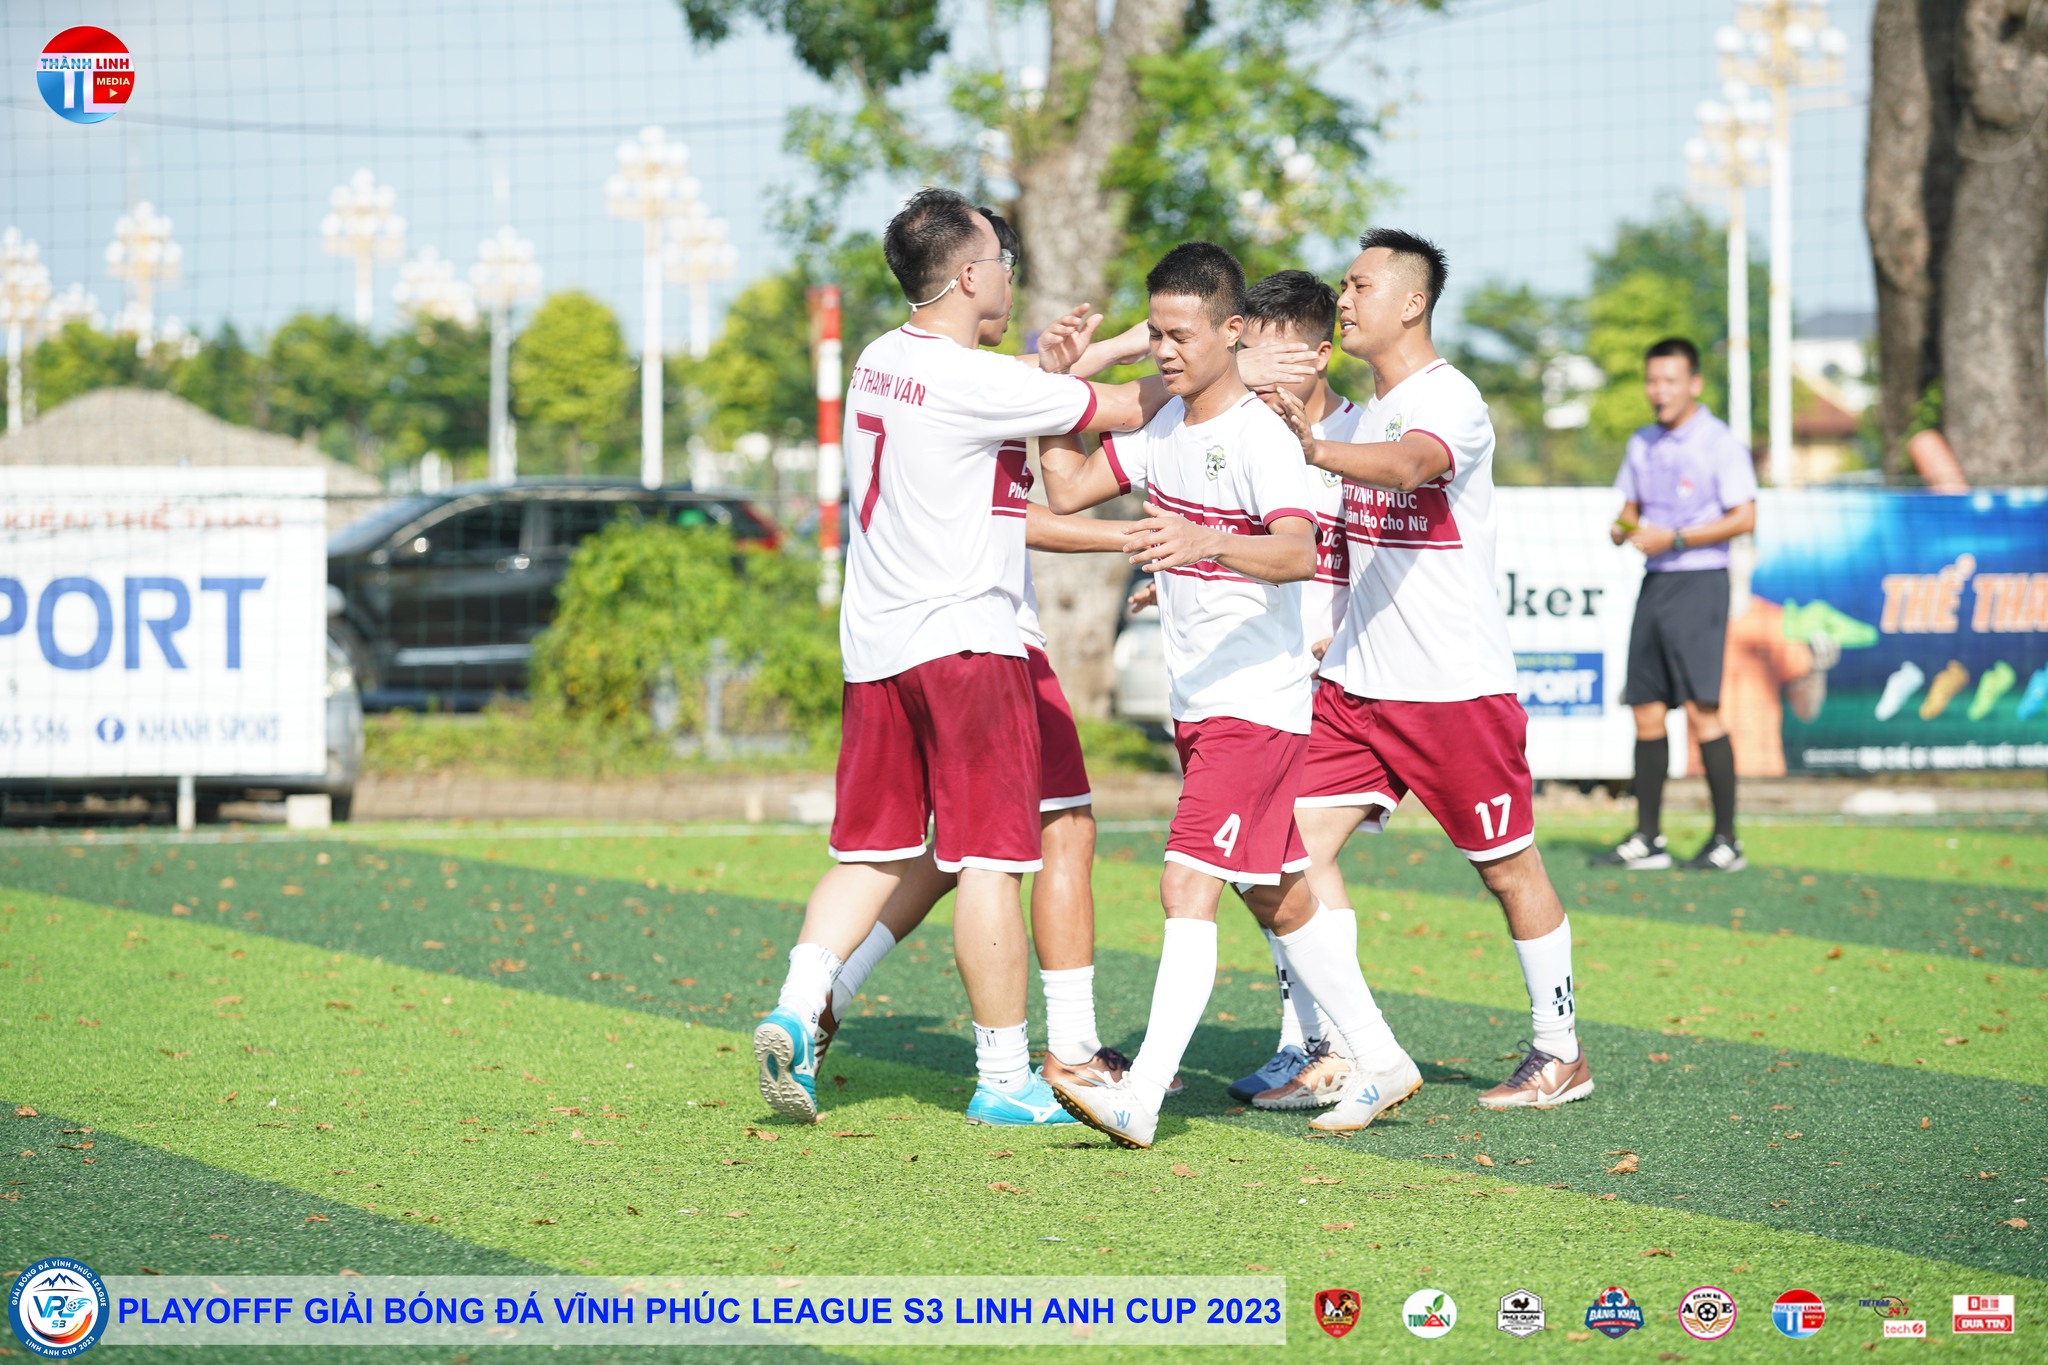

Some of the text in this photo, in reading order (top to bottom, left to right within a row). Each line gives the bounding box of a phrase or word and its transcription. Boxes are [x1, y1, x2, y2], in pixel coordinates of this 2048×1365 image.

[859, 368, 894, 397] THANH
[893, 377, 926, 406] VÂN
[855, 410, 888, 536] 7
[1380, 514, 1404, 531] cho
[1408, 515, 1428, 533] Nữ
[1497, 573, 1602, 616] ker
[1213, 813, 1241, 858] 4
[1475, 793, 1512, 840] 17
